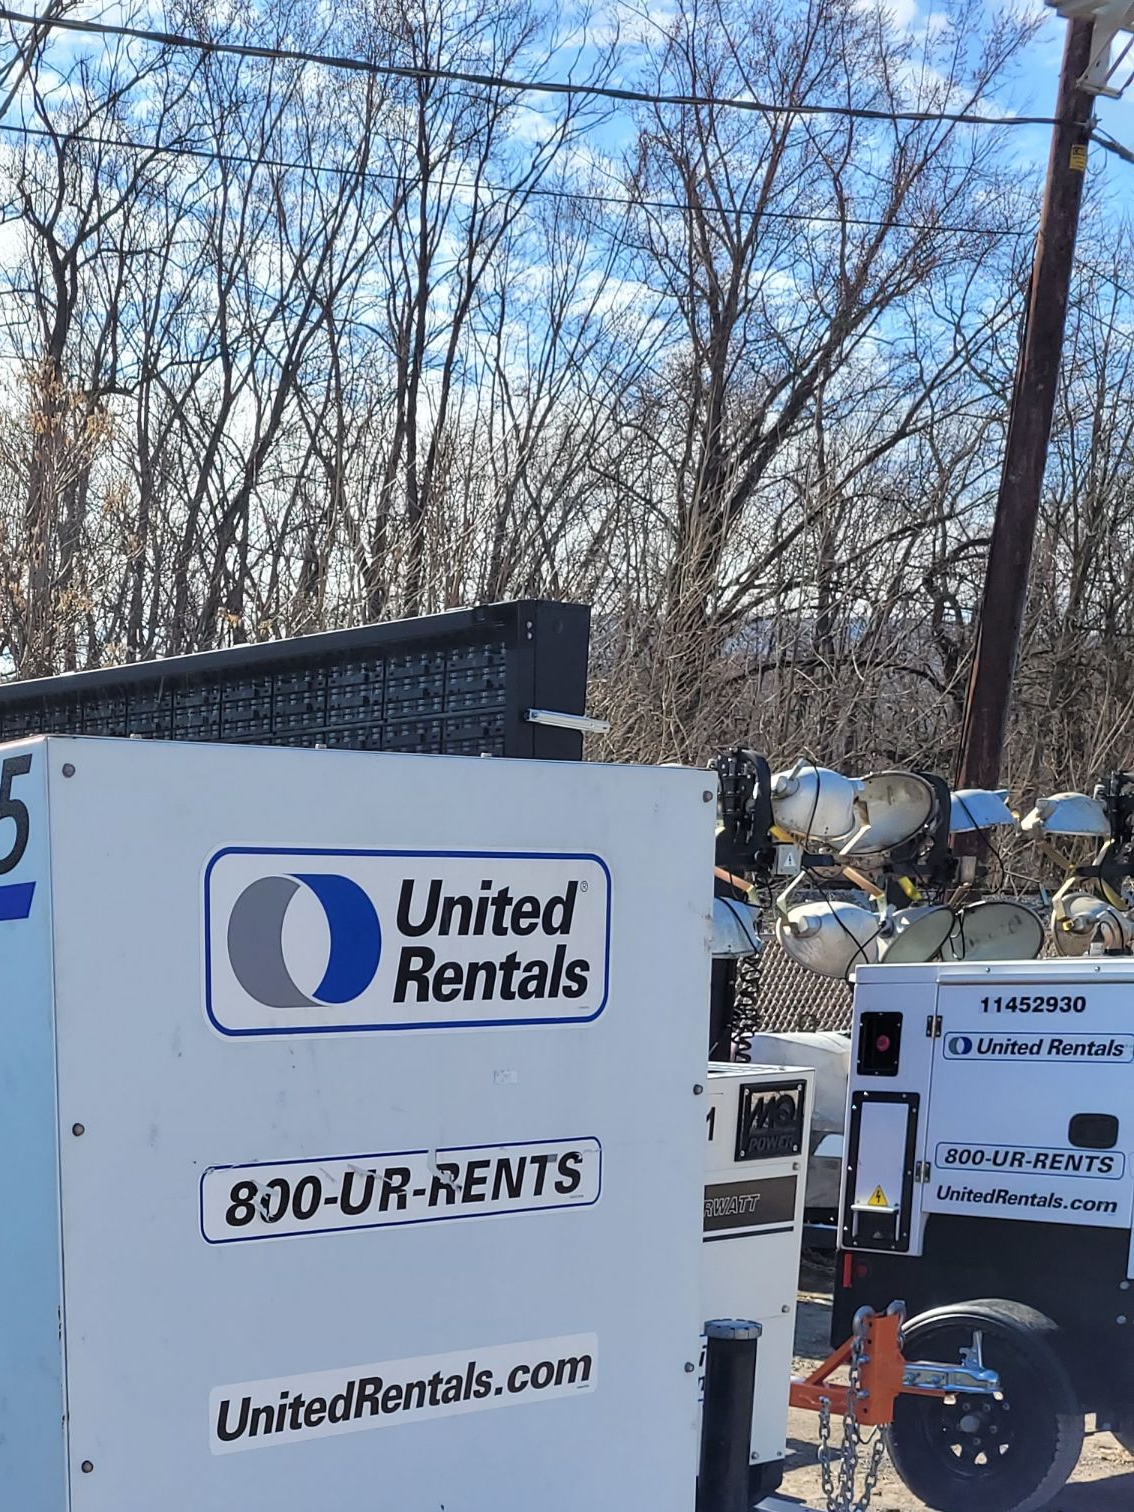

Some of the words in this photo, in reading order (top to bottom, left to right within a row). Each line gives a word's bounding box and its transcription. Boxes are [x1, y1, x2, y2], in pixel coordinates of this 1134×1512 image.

[396, 878, 579, 938] United
[392, 943, 590, 1004] Rentals
[980, 996, 1087, 1014] 11452930
[977, 1037, 1044, 1056] United
[1046, 1038, 1125, 1057] Rentals
[748, 1134, 794, 1152] POWER
[943, 1148, 1115, 1174] 800-UR-RENTS
[225, 1150, 584, 1229] 800-UR-RENTS
[936, 1184, 1118, 1214] UnitedRentals.com
[216, 1354, 593, 1442] UnitedRentals.com
